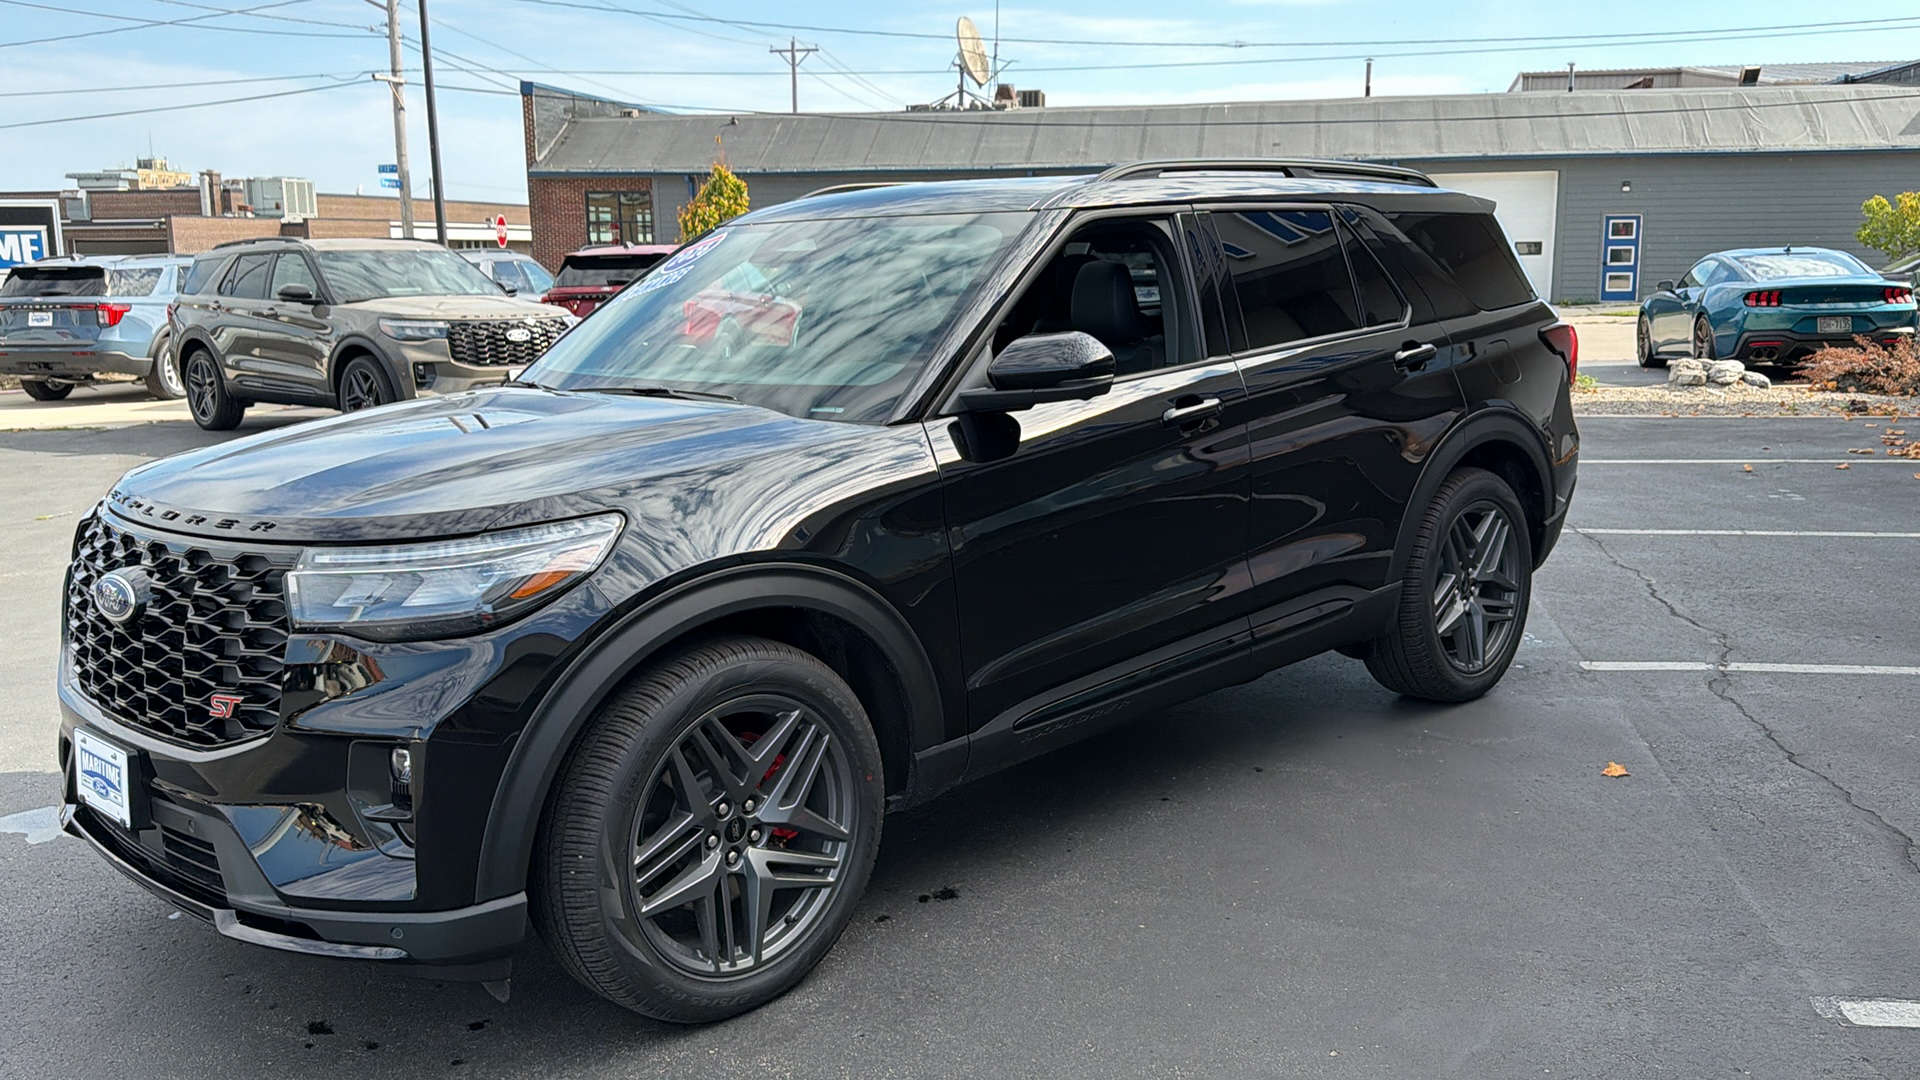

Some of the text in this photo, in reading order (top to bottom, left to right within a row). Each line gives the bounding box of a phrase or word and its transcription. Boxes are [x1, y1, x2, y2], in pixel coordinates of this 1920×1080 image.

[110, 490, 277, 532] EXPLORER
[209, 694, 244, 718] ST
[81, 749, 121, 790] MARITIME
